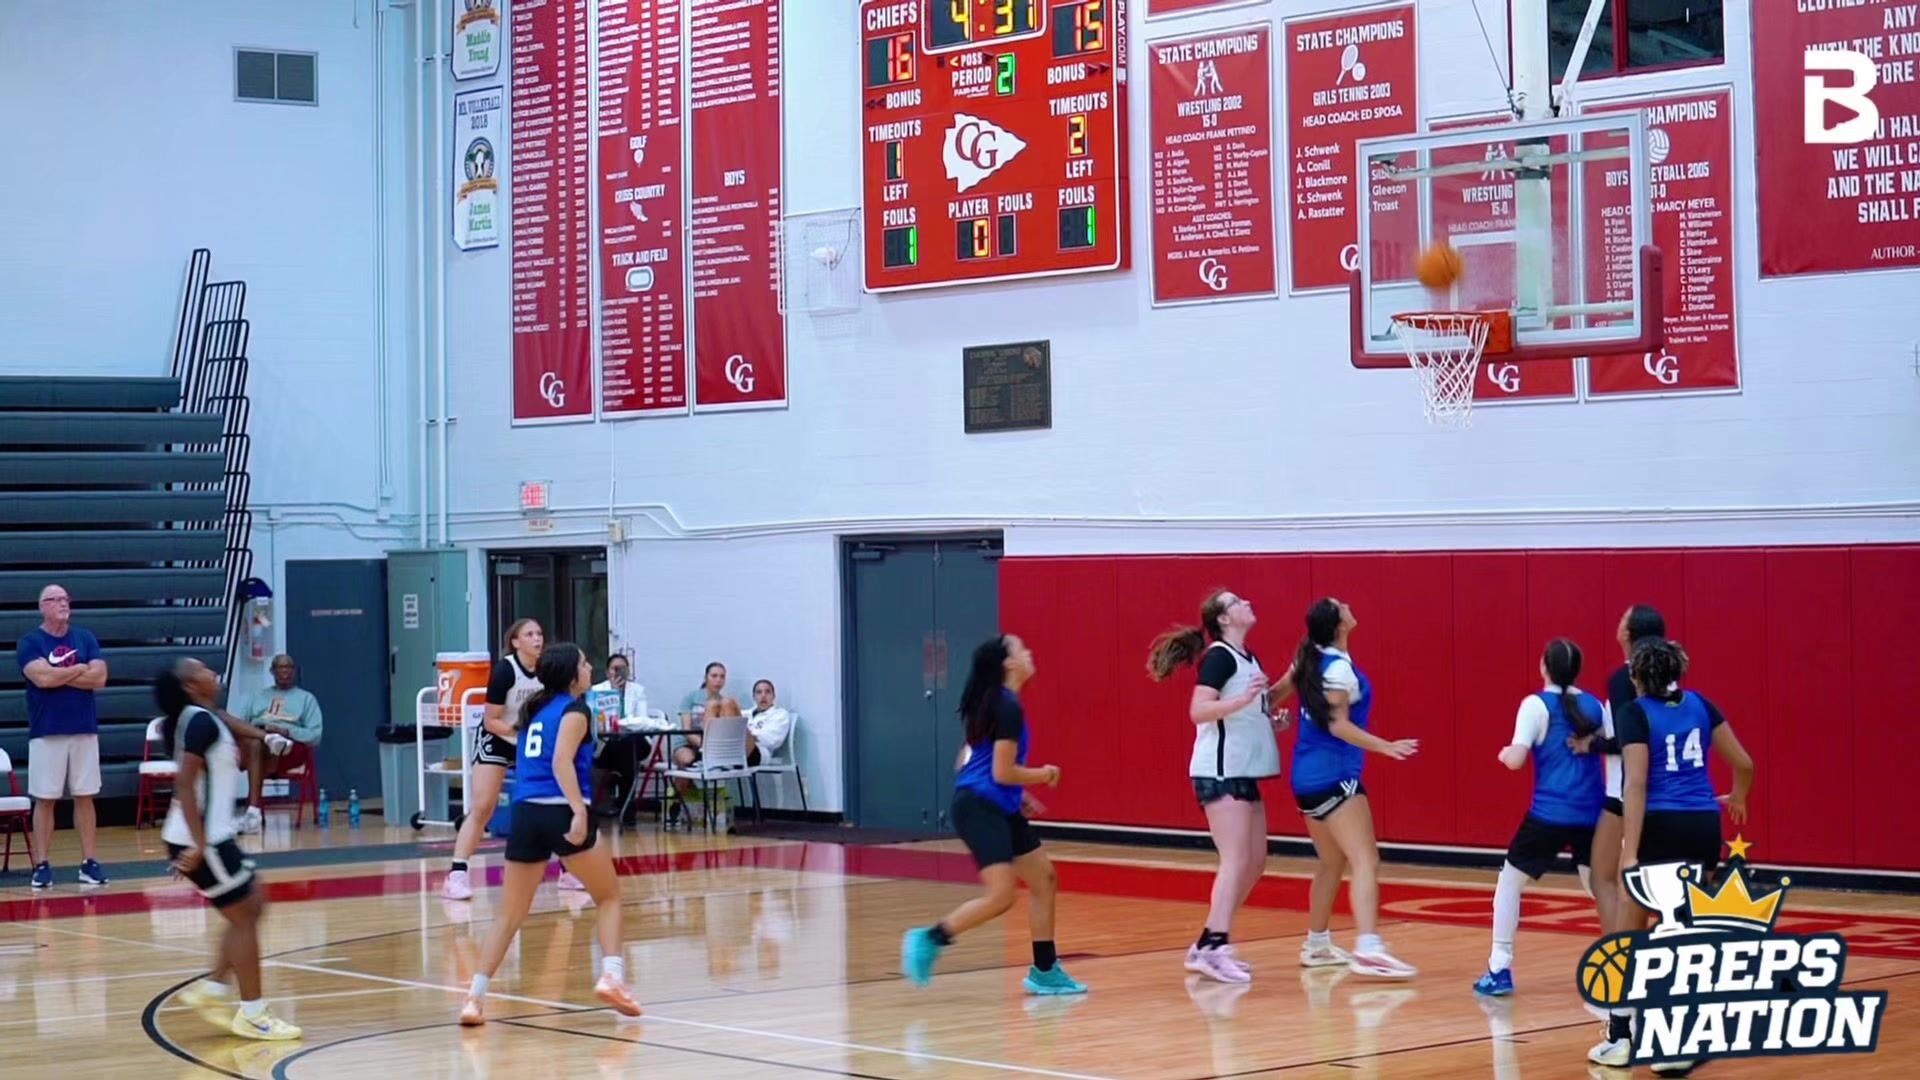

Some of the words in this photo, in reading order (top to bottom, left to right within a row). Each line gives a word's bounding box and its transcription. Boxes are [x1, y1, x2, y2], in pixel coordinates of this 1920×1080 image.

[867, 2, 918, 31] CHIEFS
[1074, 2, 1105, 51] 15
[1883, 4, 1918, 30] ANY
[1296, 30, 1333, 52] STATE
[1335, 20, 1405, 47] CHAMPIONS
[886, 34, 914, 82] 16
[961, 52, 983, 67] POSS
[1158, 44, 1193, 65] STATE
[1194, 34, 1259, 60] CHAMPIONS
[952, 66, 993, 89] PERIOD
[998, 55, 1014, 94] 2
[1047, 63, 1086, 85] BONUS
[886, 89, 922, 110] BONUS
[1049, 92, 1108, 116] TIMEOUTS
[1177, 97, 1222, 117] WRESTLING
[1313, 89, 1337, 107] GIRLS
[1338, 85, 1369, 104] TENNIS
[1303, 114, 1326, 128] HEAD
[1327, 110, 1359, 124] COACH:
[1361, 108, 1372, 120] ED
[1374, 104, 1403, 119] SPOSA
[1647, 100, 1718, 125] HAMPIONS
[868, 119, 922, 143] TIMEOUTS
[1068, 116, 1086, 155] 2
[1165, 134, 1182, 146] HEAD
[1206, 128, 1227, 140] FRANK
[955, 122, 999, 170] CG
[1296, 147, 1302, 158] J.
[1304, 143, 1341, 157] Schwenk
[1833, 148, 1860, 172] WE
[1864, 144, 1905, 169] WILL
[724, 169, 746, 187] BOYS
[1065, 159, 1094, 179] LEFT
[1296, 163, 1305, 174] A.
[1605, 170, 1629, 187] BOYS
[1687, 161, 1710, 179] 2005
[883, 183, 909, 202] LEFT
[1297, 178, 1303, 189] J.
[1305, 175, 1348, 188] Blackmore
[1372, 184, 1407, 196] Gleeson
[1462, 184, 1514, 203] WRESTLING
[1827, 175, 1861, 199] AND
[1864, 172, 1896, 196] THE
[948, 198, 990, 219] PLAYER
[998, 193, 1033, 213] FOULS
[1058, 185, 1095, 206] FOULS
[1297, 194, 1305, 204] K.
[1306, 189, 1343, 203] Schwenk
[1372, 200, 1399, 212] Troast
[1601, 206, 1624, 218] HEAD
[1656, 200, 1687, 213] MARCY
[1687, 197, 1716, 210] MEYER
[883, 207, 917, 226] FOULS
[1297, 209, 1306, 220] A.
[1308, 206, 1345, 218] Rastatter
[1858, 198, 1910, 224] SHALL
[973, 218, 989, 258] 0
[1871, 245, 1916, 260] AUTHOR
[1198, 257, 1228, 291] CG
[725, 354, 755, 393] CG
[524, 722, 544, 758] 6
[1665, 728, 1704, 772] 14
